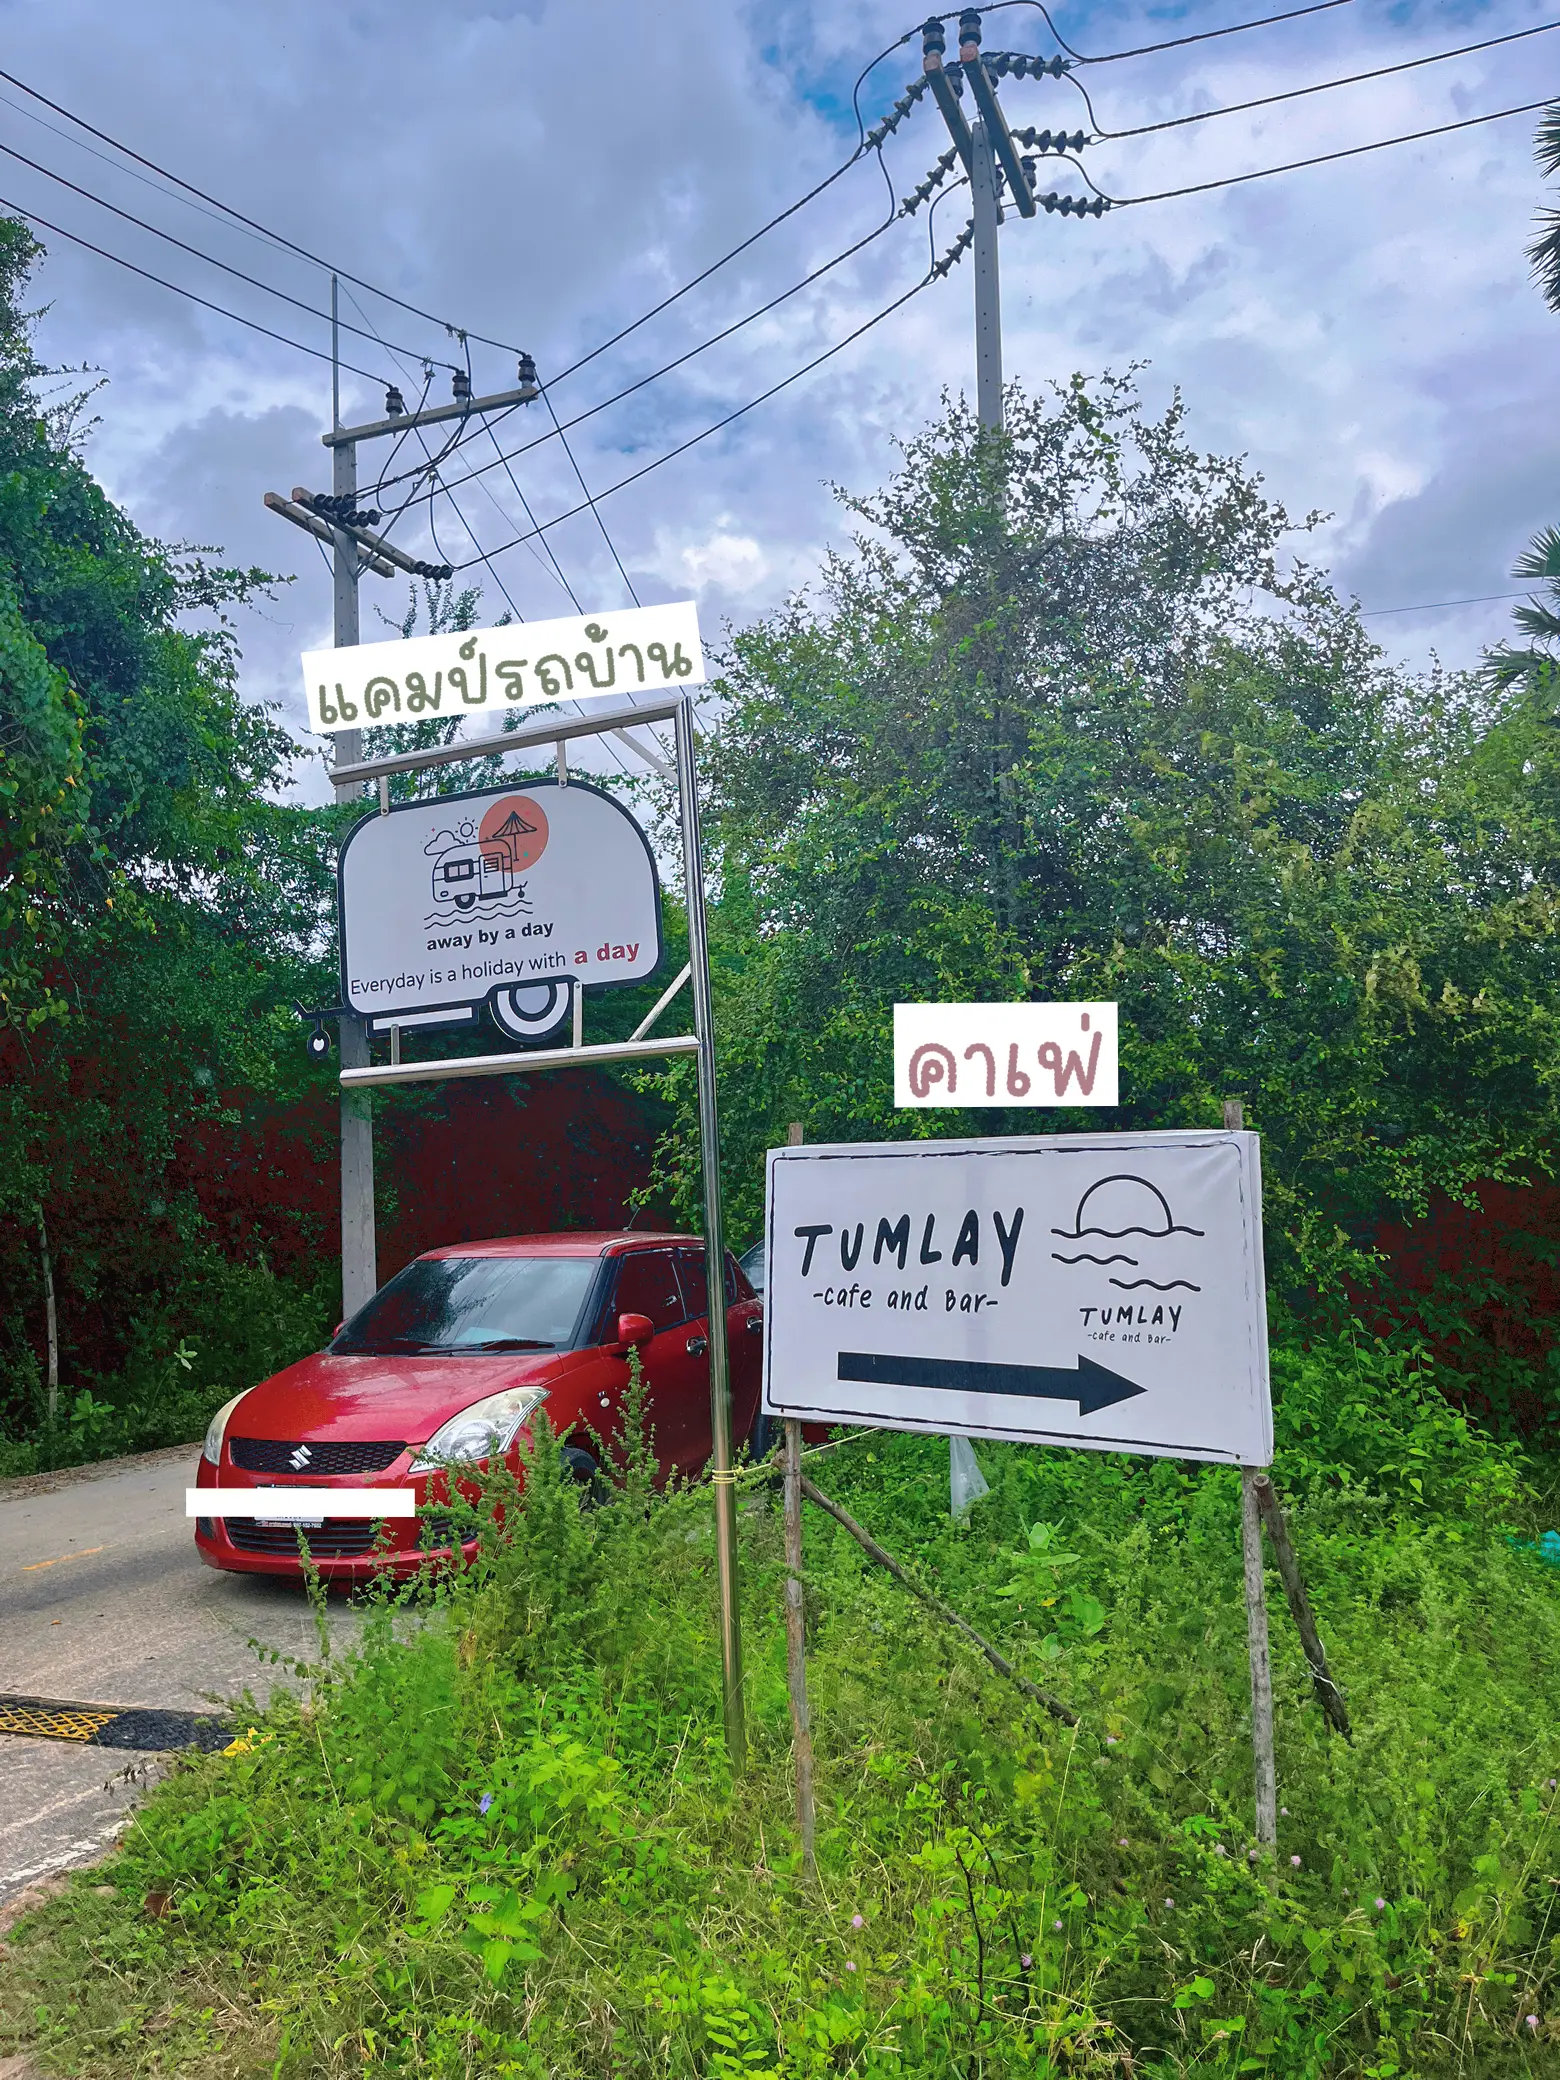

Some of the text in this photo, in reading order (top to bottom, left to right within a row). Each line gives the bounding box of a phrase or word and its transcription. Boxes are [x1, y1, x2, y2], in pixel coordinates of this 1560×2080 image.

[426, 921, 554, 951] away by a day
[351, 942, 640, 995] Everyday is a holiday with a day
[794, 1207, 1024, 1287] TUMLAY
[887, 1284, 928, 1311] and
[1079, 1305, 1182, 1332] TUMLAY
[1122, 1332, 1141, 1343] and
